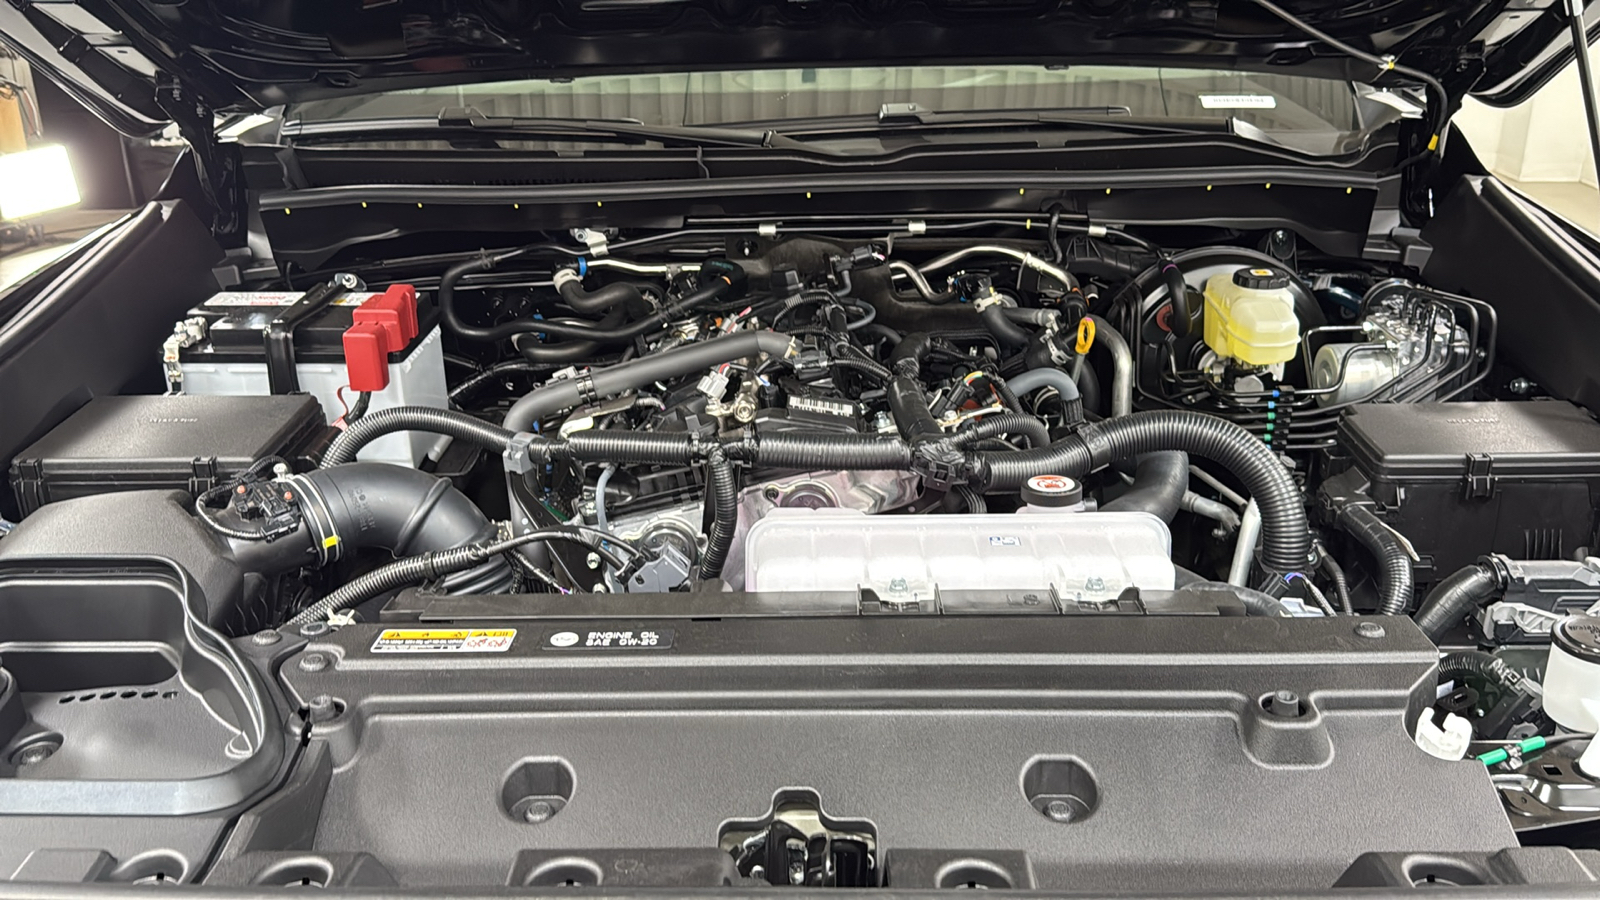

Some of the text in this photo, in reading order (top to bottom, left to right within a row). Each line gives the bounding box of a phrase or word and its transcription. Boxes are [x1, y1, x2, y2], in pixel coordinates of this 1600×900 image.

[587, 631, 659, 639] ENGINE OIL
[585, 638, 611, 646] SAE
